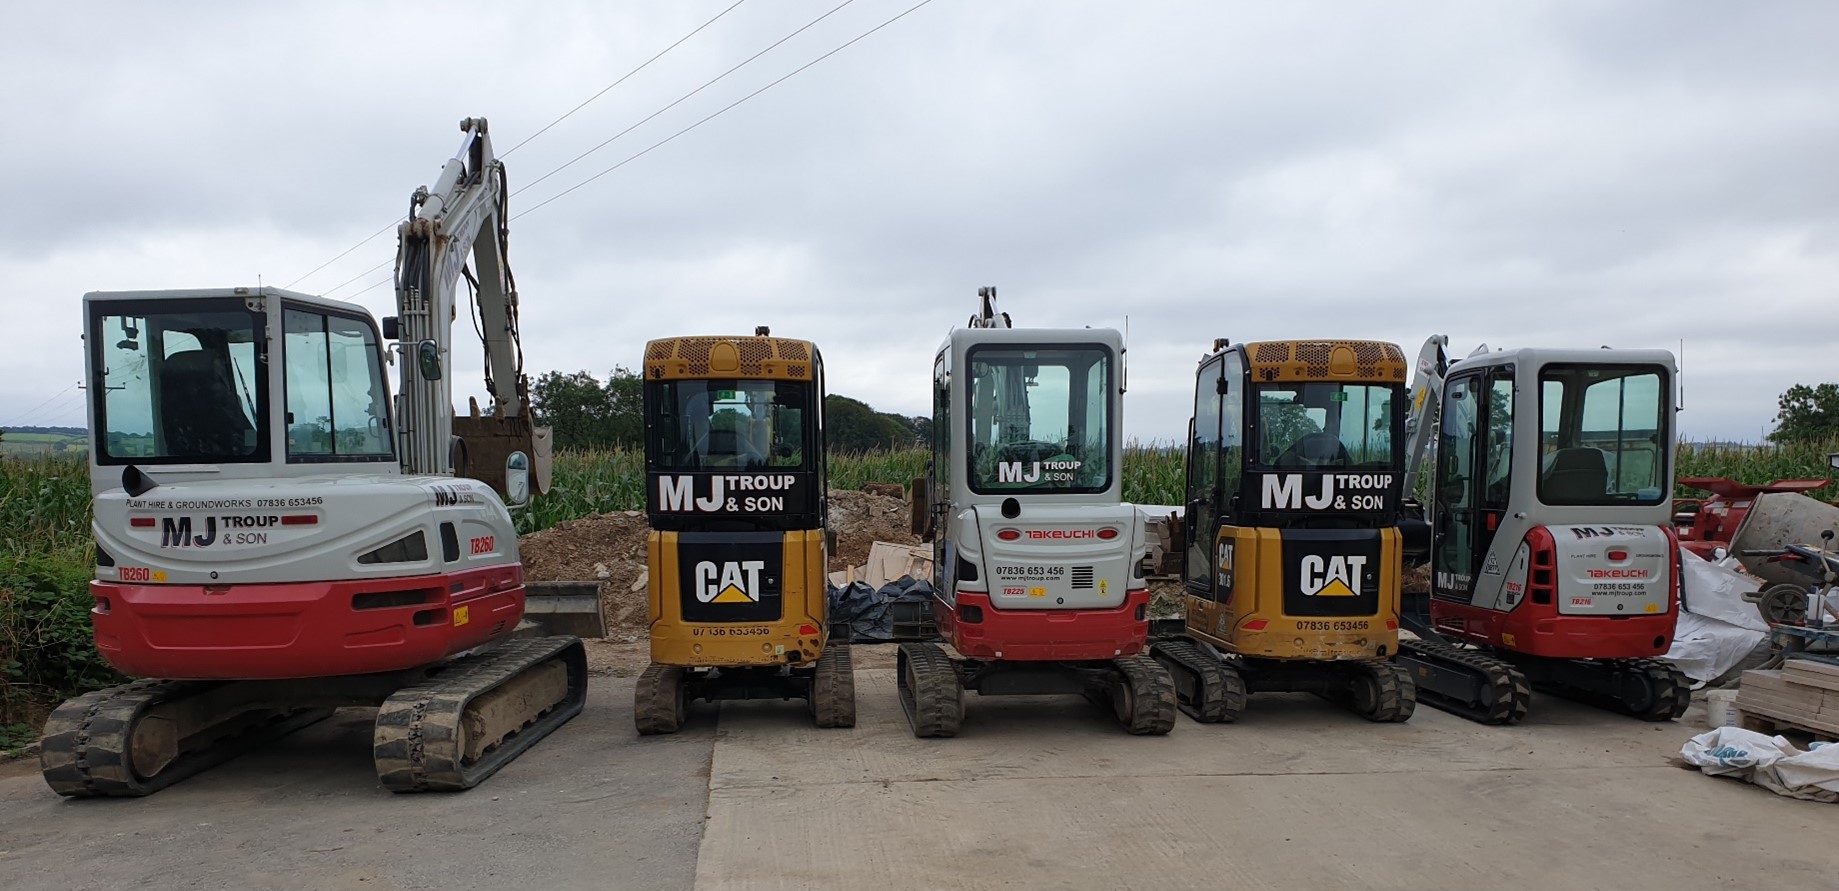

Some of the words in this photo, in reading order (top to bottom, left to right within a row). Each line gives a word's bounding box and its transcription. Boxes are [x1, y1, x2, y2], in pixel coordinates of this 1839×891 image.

[997, 461, 1041, 484] MJ
[1043, 461, 1082, 470] TROUP
[1053, 473, 1074, 481] SON
[658, 475, 725, 513] MJ
[725, 475, 796, 491] TROUP
[1261, 473, 1335, 510] MJ
[1335, 474, 1393, 489] TROUP
[125, 498, 147, 509] PLANT
[148, 501, 166, 509] HIRE
[167, 501, 174, 509] &
[175, 500, 252, 509] GROUNDWORKS
[257, 499, 286, 508] 07836
[288, 496, 324, 507] 653456
[725, 496, 739, 512] &
[744, 496, 784, 512] SON
[1334, 495, 1347, 510] &
[1351, 495, 1384, 510] SON
[161, 516, 217, 548] MJ
[221, 515, 279, 529] TROUP
[222, 533, 232, 545] &
[235, 532, 267, 545] SON
[1570, 526, 1615, 540] MJ
[470, 535, 495, 554] TB260
[1219, 543, 1234, 571] CAT
[118, 566, 150, 581] TB260
[995, 566, 1025, 575] 07836
[1027, 566, 1045, 575] 653
[1047, 566, 1065, 575] 456
[1300, 555, 1367, 597] CAT
[695, 560, 765, 603] CAT
[1437, 571, 1454, 590] MJ
[729, 625, 770, 636] 653456
[1296, 620, 1330, 631] 07836
[1333, 620, 1369, 631] 653456
